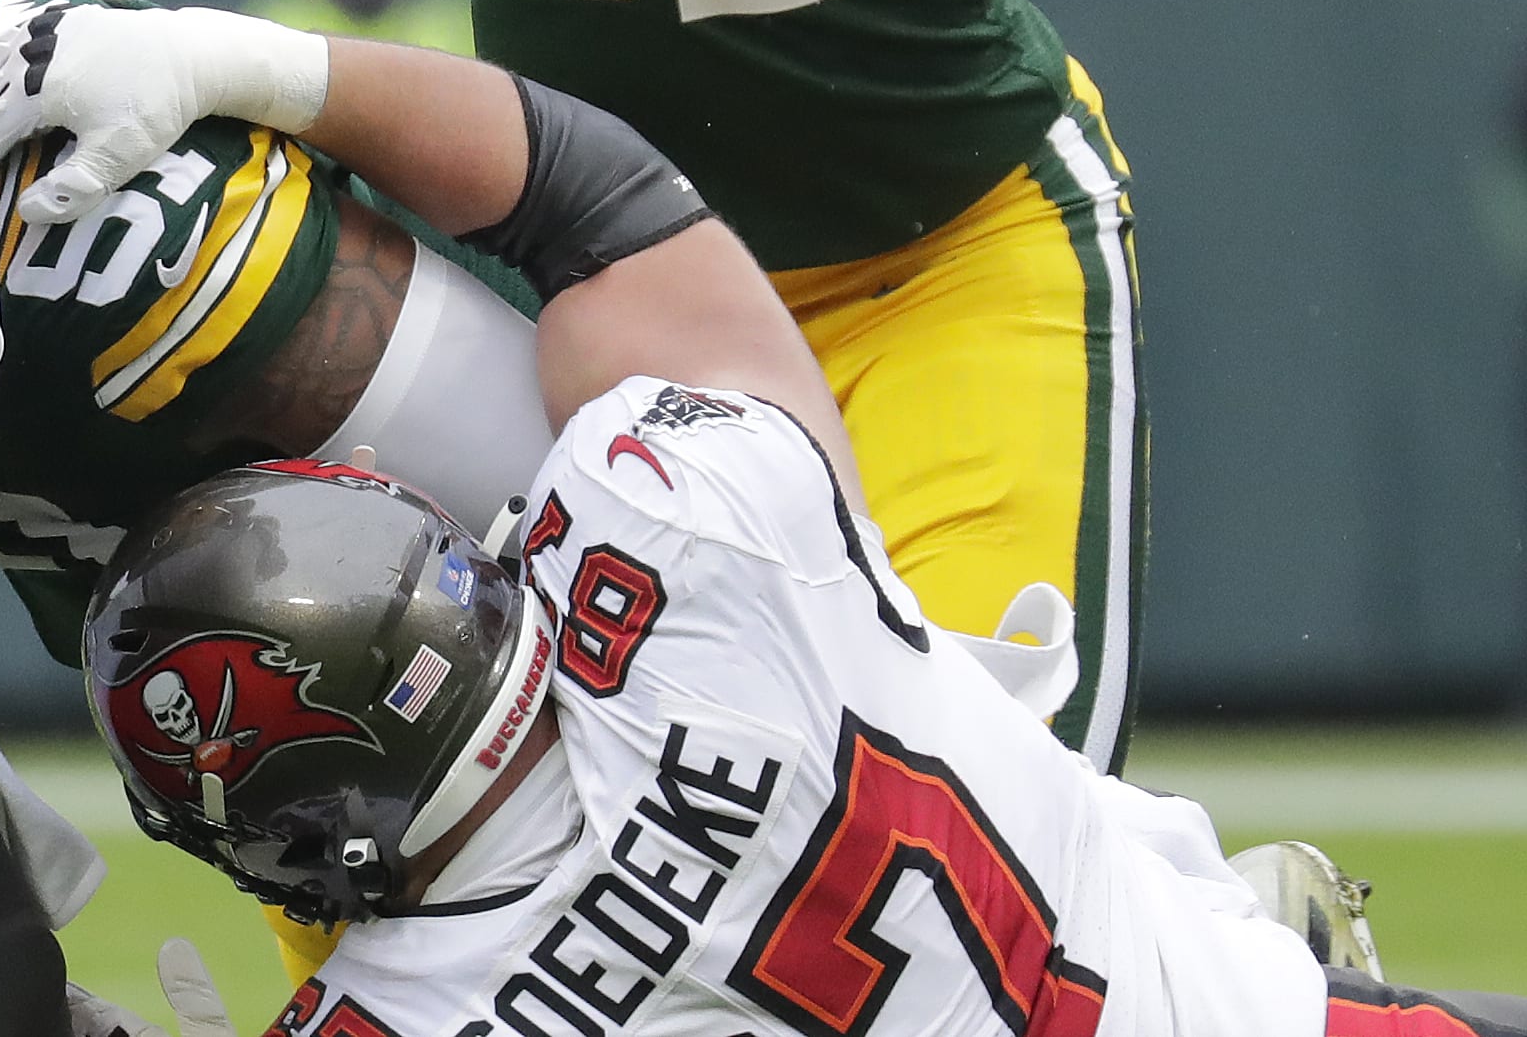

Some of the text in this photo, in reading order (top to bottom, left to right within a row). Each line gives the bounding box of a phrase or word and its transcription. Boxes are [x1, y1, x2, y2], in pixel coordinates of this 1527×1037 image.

[475, 625, 553, 770] BUCCANEERS
[455, 724, 783, 1037] OEDEKE
[725, 705, 1108, 1037] 7
